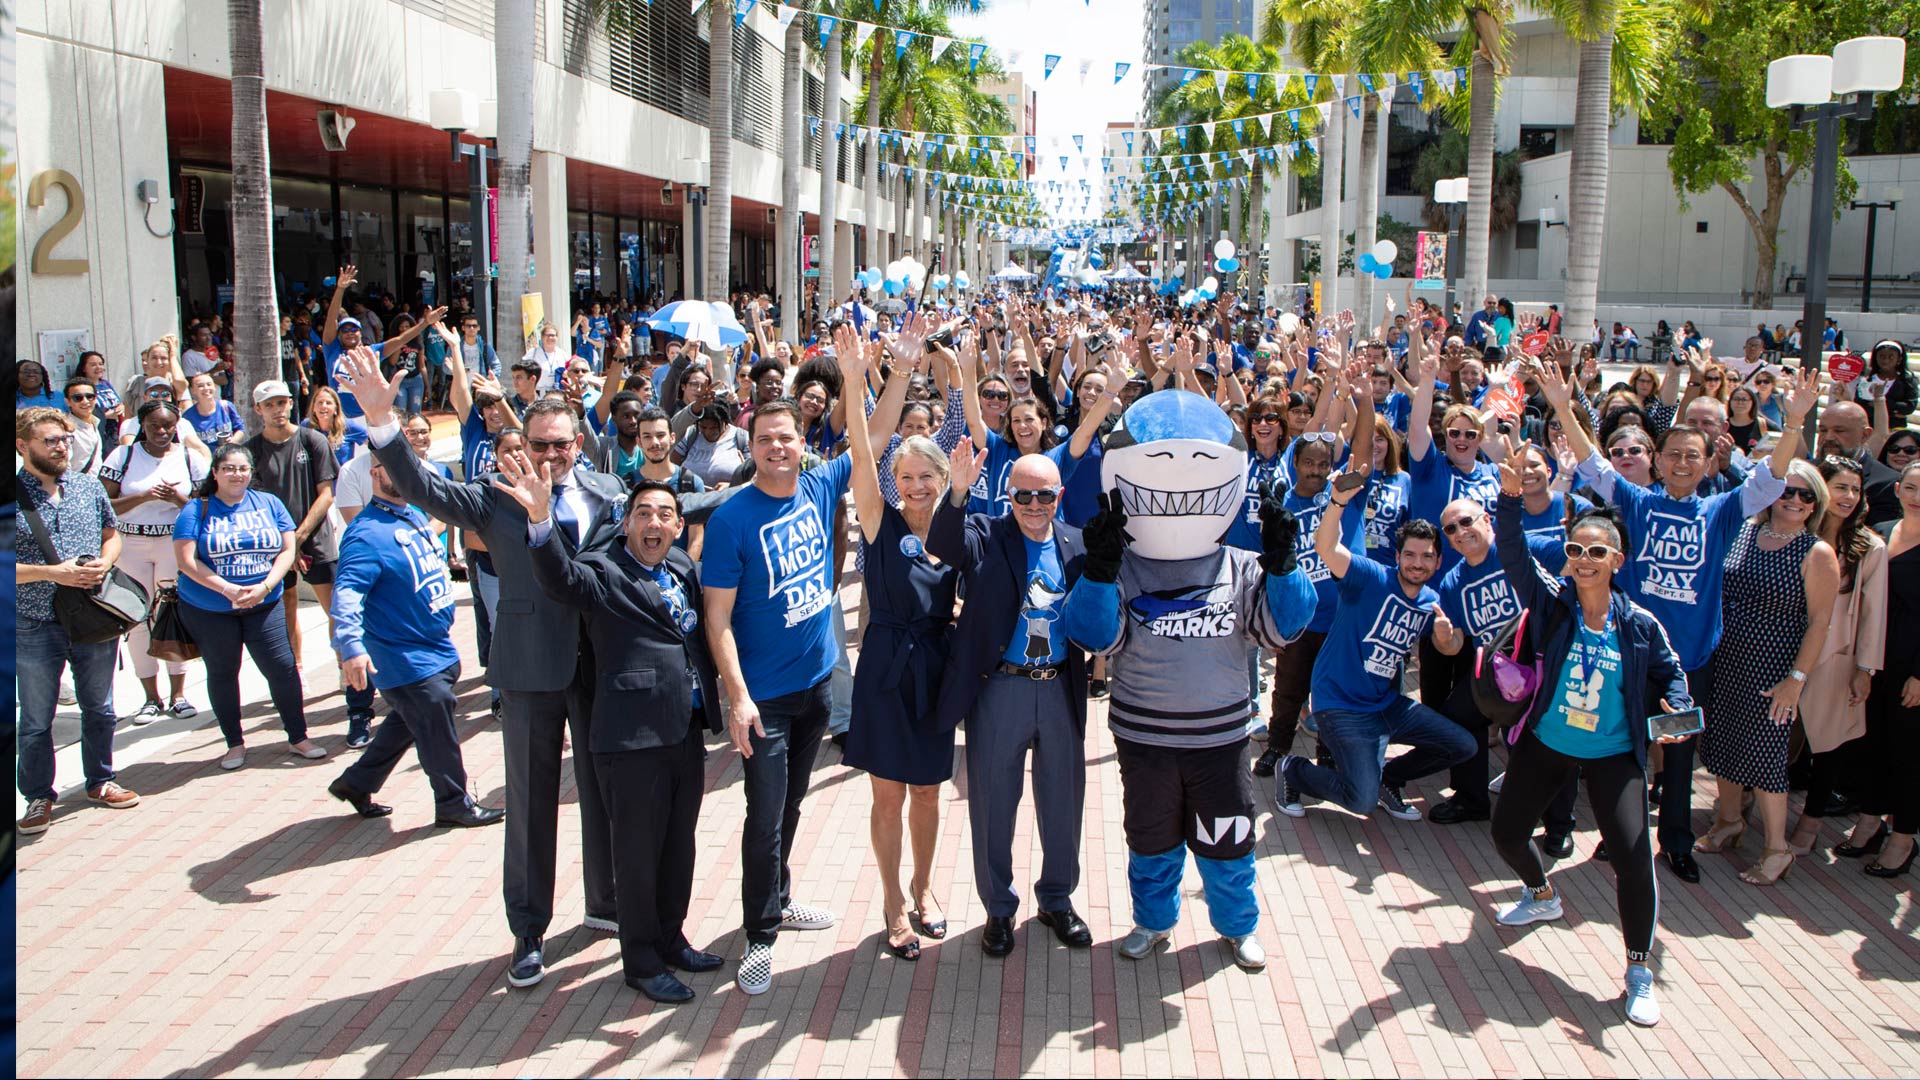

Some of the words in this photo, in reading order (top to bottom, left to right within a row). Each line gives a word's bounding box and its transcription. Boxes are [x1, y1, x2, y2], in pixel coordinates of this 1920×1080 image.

[28, 169, 90, 274] 2
[233, 508, 271, 532] JUST
[1365, 520, 1390, 536] AY
[1651, 521, 1658, 536] I
[1661, 525, 1697, 543] AM
[207, 531, 244, 554] LIKE
[248, 528, 282, 549] YOU
[773, 533, 784, 553] I
[788, 515, 818, 549] AM
[778, 538, 823, 577] MDC
[1650, 538, 1698, 562] MDC
[1646, 563, 1697, 590] DAY
[1470, 592, 1478, 609] I
[1481, 579, 1509, 605] AM
[1653, 586, 1677, 598] SEPT.
[1207, 601, 1234, 615] MDC
[1390, 604, 1398, 621] I
[1397, 610, 1423, 631] AM
[1472, 599, 1515, 627] MDC
[1151, 612, 1237, 637] SHARKS
[1380, 621, 1417, 648] MDC
